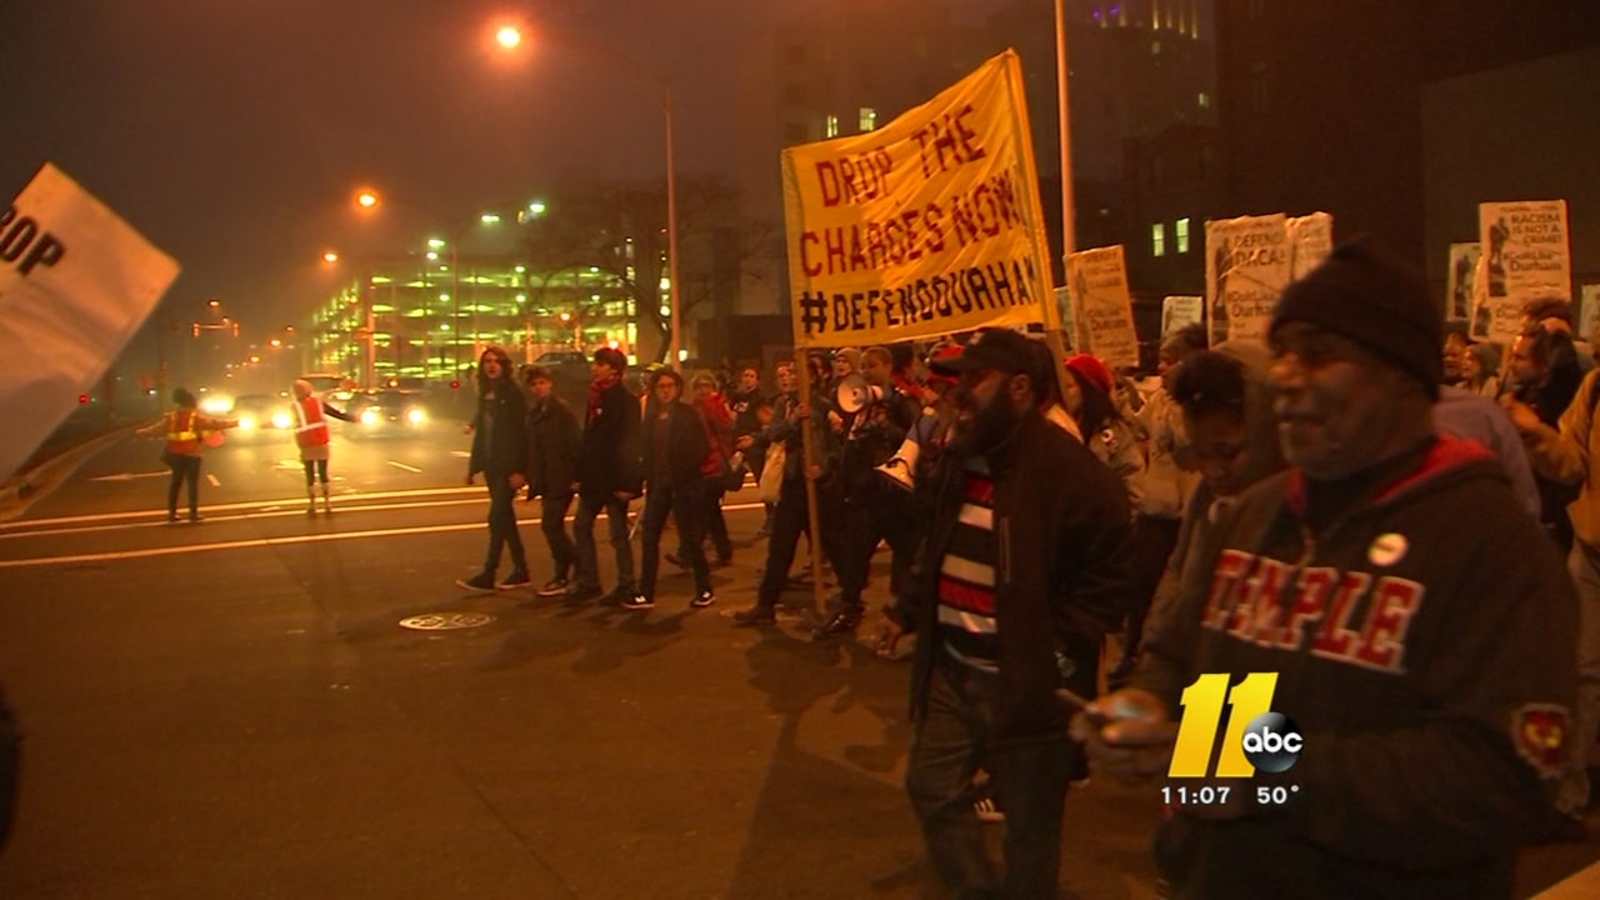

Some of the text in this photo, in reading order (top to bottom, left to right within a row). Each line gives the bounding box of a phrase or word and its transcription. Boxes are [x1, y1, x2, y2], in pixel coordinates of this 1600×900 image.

[815, 104, 986, 207] DROP THE
[800, 168, 1024, 277] CHARGES NOW
[1510, 213, 1560, 223] RACISM
[1511, 223, 1561, 234] IS NOT A
[1234, 232, 1282, 247] DEFEND
[1510, 260, 1562, 271] Durham
[1201, 549, 1424, 674] TEMPLE
